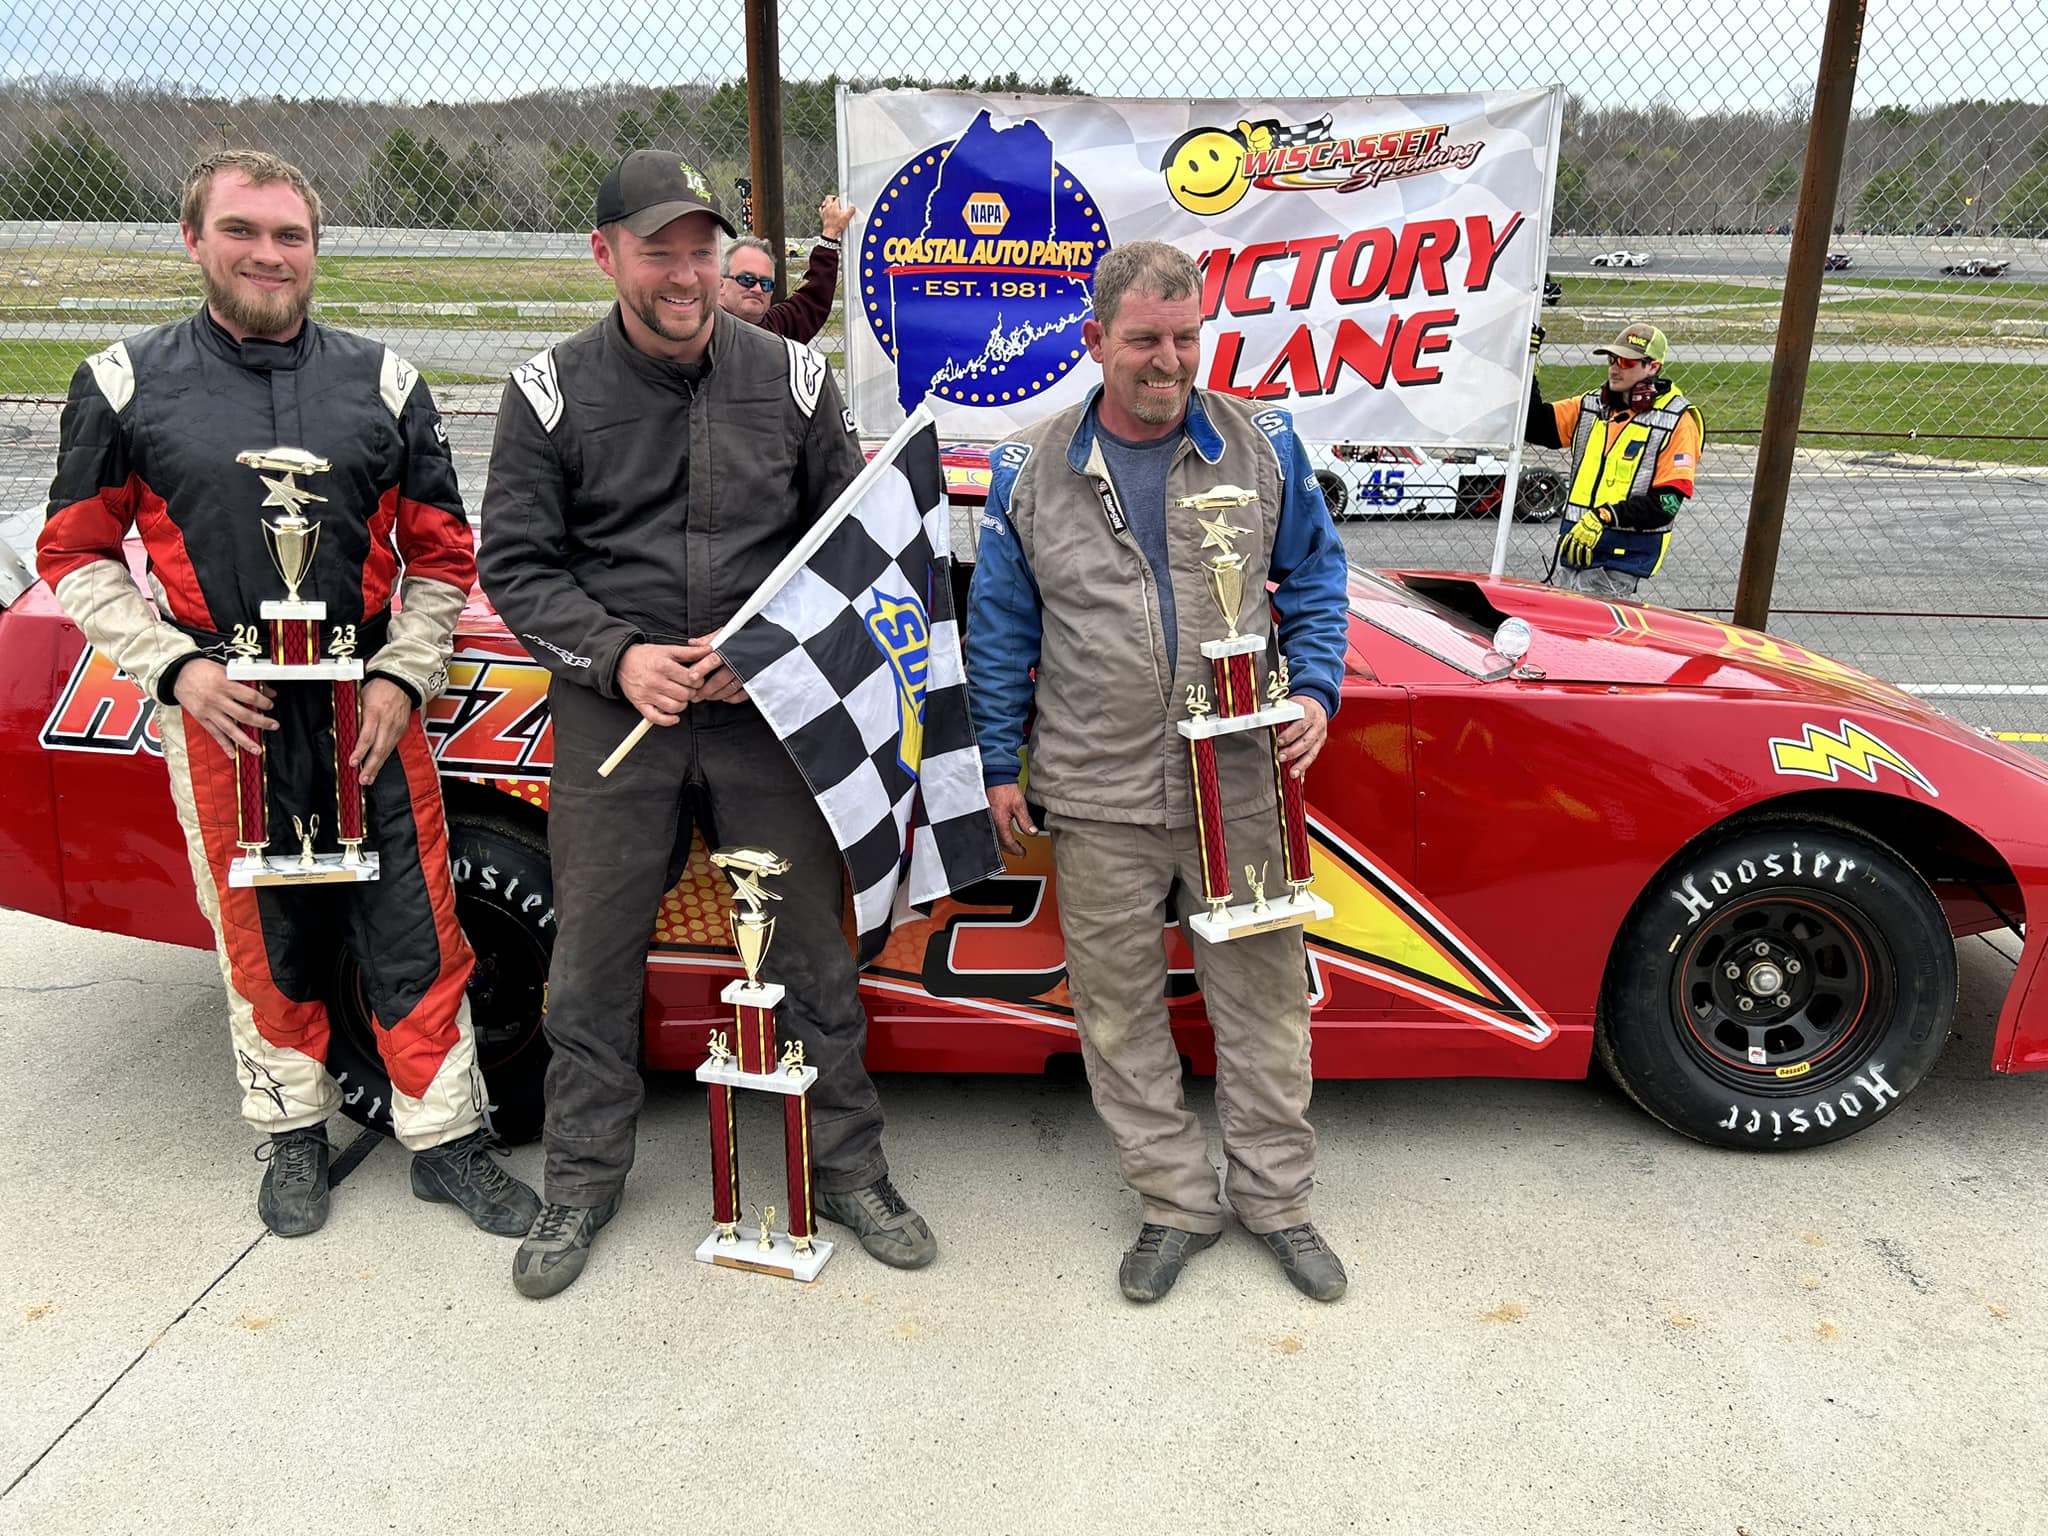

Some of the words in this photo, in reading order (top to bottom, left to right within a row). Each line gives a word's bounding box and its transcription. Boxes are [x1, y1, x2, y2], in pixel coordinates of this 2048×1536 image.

[1243, 124, 1449, 177] WISCASSET
[1336, 141, 1485, 193] Speedway
[970, 204, 1002, 223] NAPA
[883, 237, 968, 264] COASTAL
[969, 239, 1029, 265] AUTO
[1029, 240, 1094, 266] PARTS
[1196, 211, 1525, 321] ICTORY
[925, 280, 982, 297] EST.
[990, 282, 1047, 298] 1981
[1207, 308, 1459, 400] LANE
[1363, 469, 1405, 507] 45
[1102, 494, 1124, 530] SIMPSON
[231, 623, 259, 645] 20
[330, 624, 358, 645] 23
[1185, 684, 1207, 705] 20
[1268, 666, 1291, 689] 23
[1672, 841, 1856, 925] Hoosier
[706, 1028, 728, 1048] 20
[784, 1040, 806, 1060] 23
[1718, 1063, 1900, 1142] Hoosier
